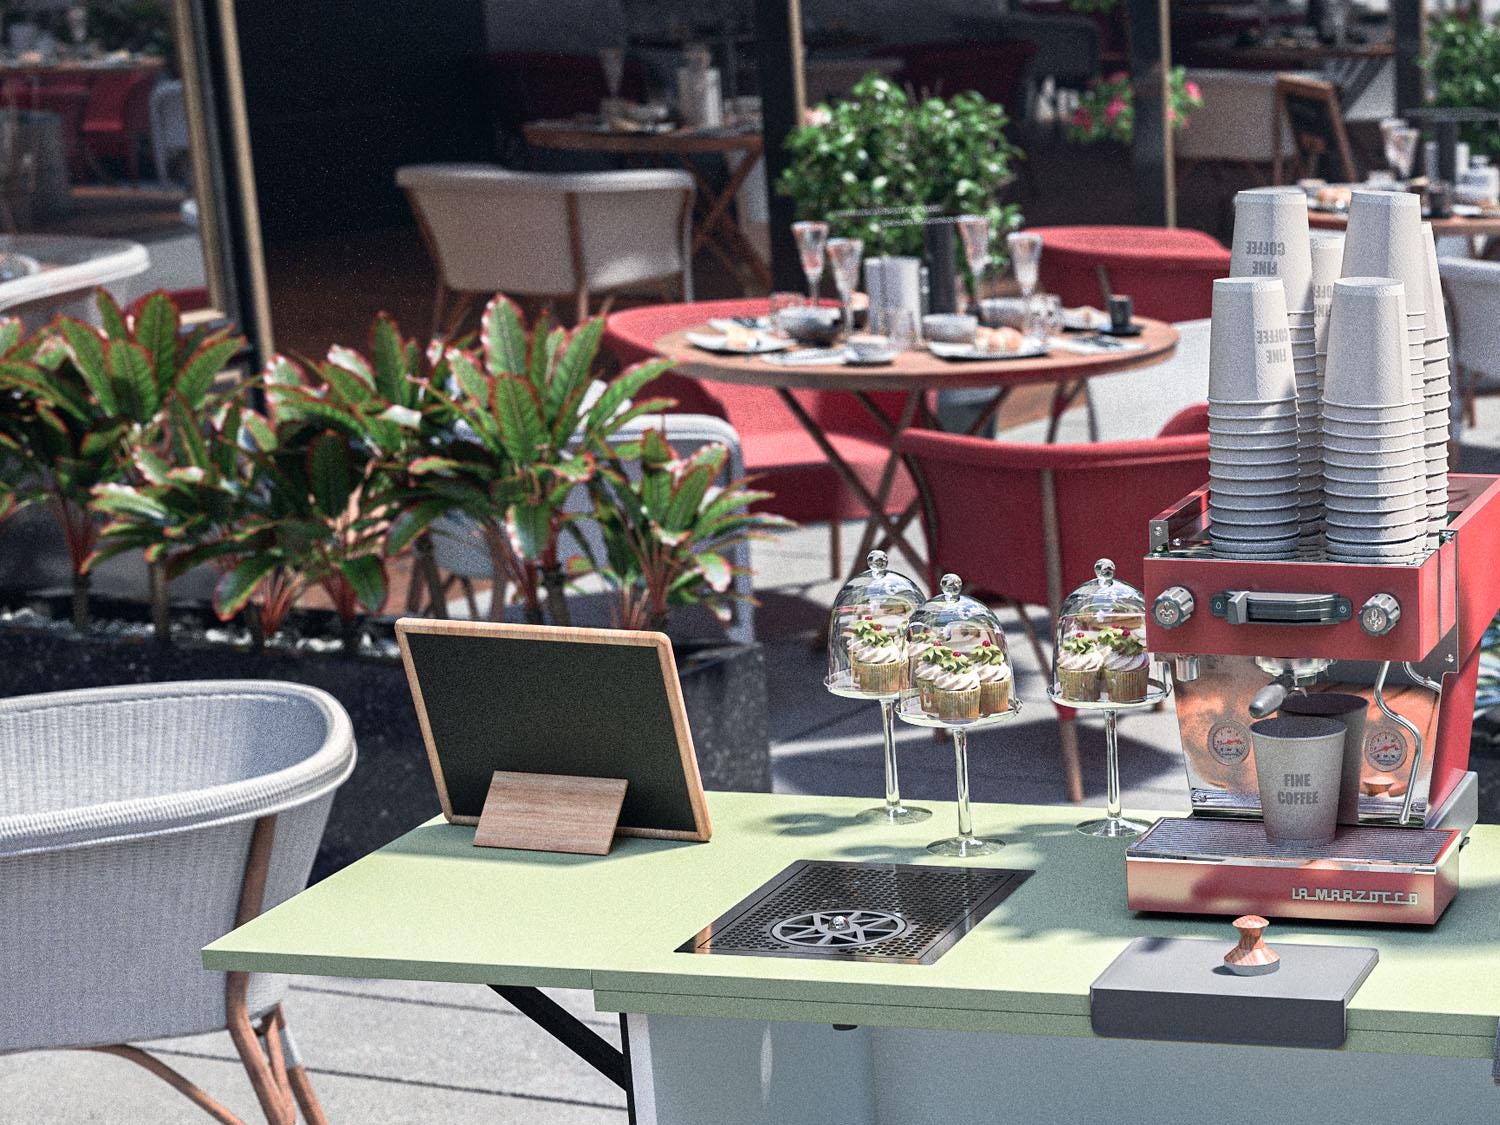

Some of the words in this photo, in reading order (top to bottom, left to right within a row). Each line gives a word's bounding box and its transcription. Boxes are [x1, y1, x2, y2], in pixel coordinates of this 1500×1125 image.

[1246, 241, 1285, 256] COFFEE
[1253, 261, 1278, 275] FINE
[1267, 348, 1287, 363] FINE
[1284, 774, 1311, 787] FINE
[1278, 791, 1319, 805] COFFEE
